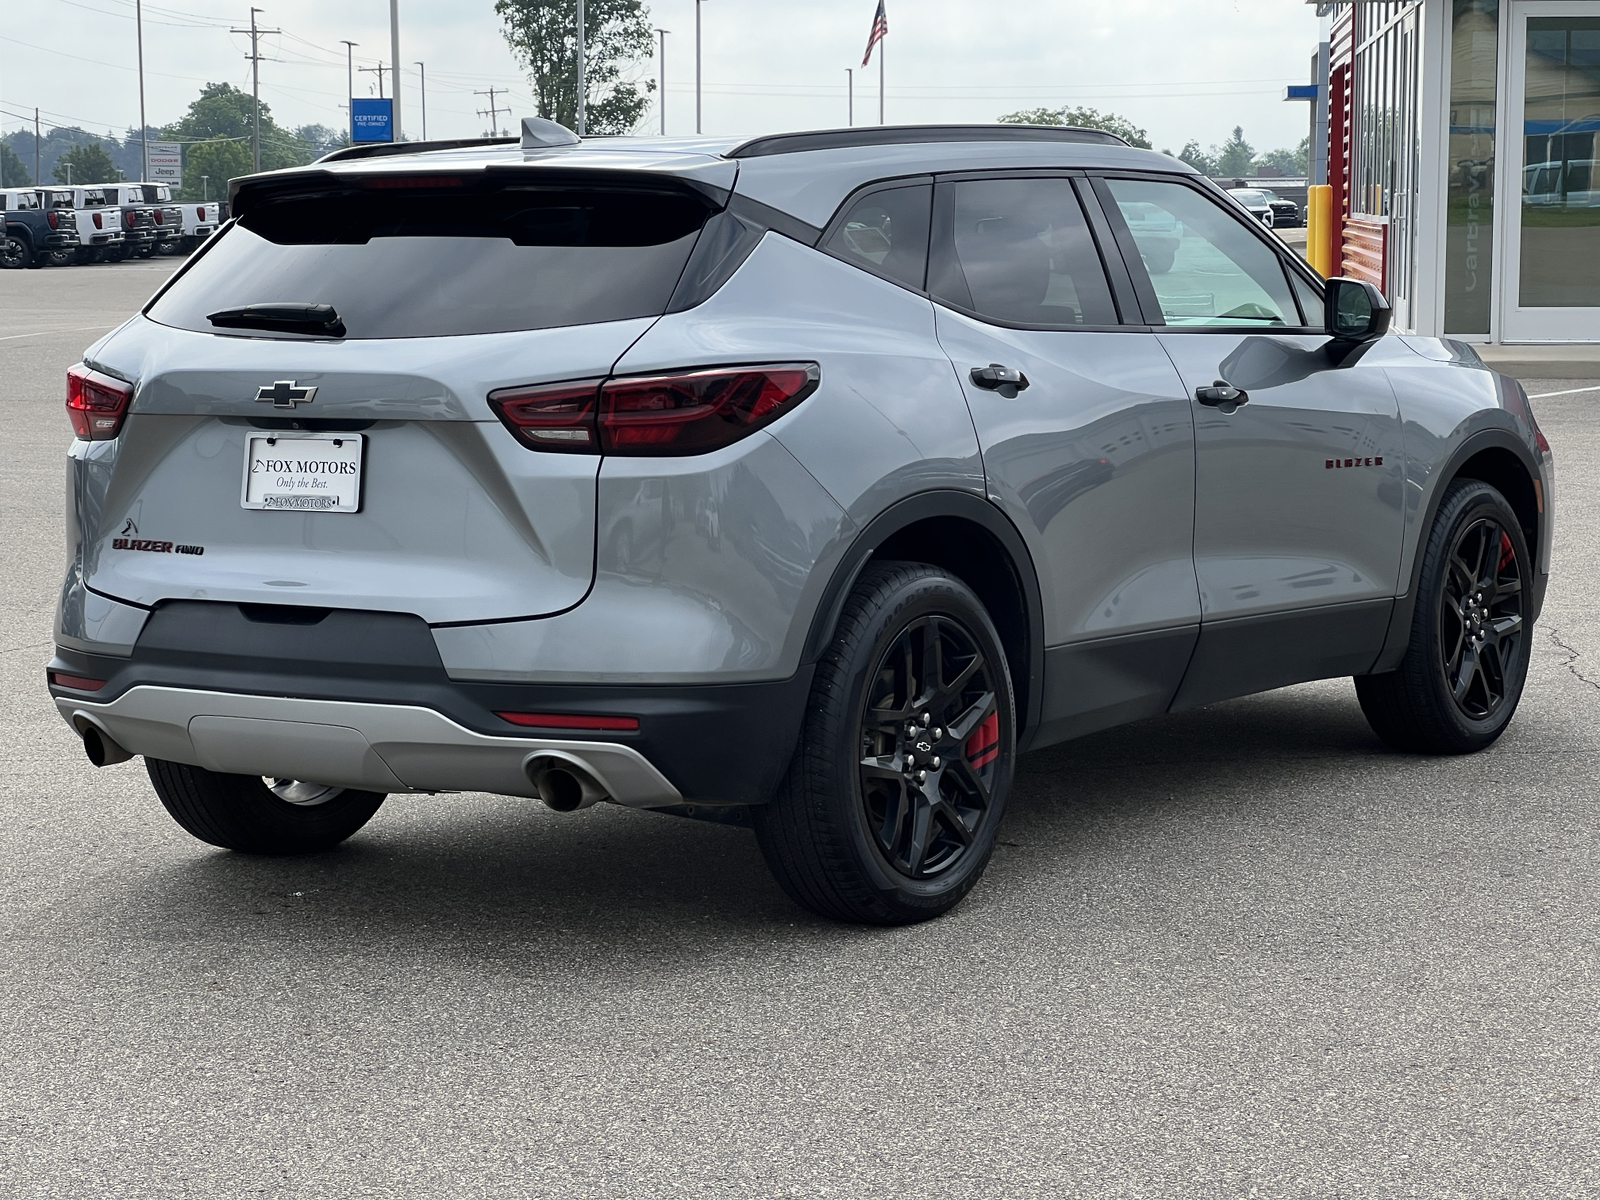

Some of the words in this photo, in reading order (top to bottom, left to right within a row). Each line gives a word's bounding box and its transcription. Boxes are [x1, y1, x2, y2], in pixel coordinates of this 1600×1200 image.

[155, 168, 175, 176] Jeep
[265, 459, 293, 473] FOX
[295, 460, 356, 475] MOTORS
[1325, 456, 1383, 469] BLAZER
[276, 476, 296, 491] Only
[297, 476, 309, 489] the
[311, 477, 328, 489] Best.
[112, 538, 173, 553] BLAZER
[175, 544, 205, 555] AWD
